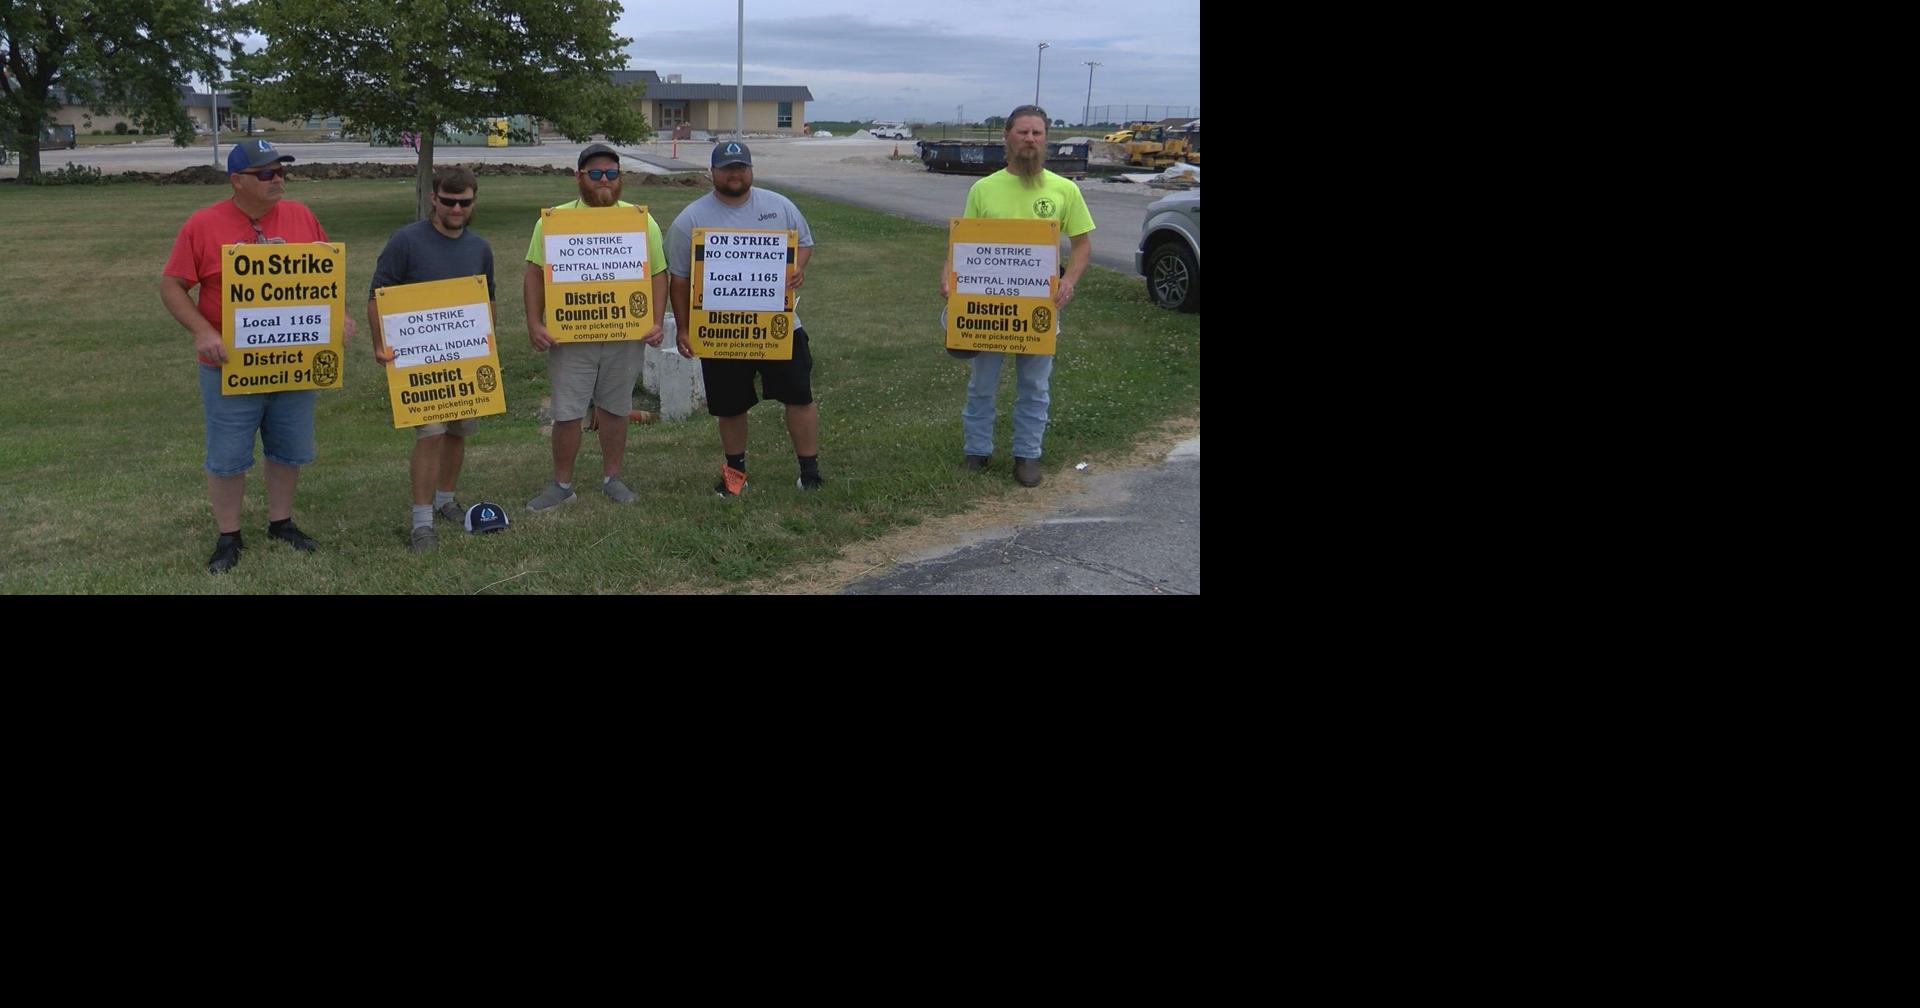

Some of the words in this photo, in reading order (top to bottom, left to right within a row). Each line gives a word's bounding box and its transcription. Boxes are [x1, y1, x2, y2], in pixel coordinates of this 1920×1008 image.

[758, 212, 777, 222] Jeep
[569, 237, 583, 246] ON
[586, 236, 623, 245] STRIKE
[710, 236, 728, 245] ON
[733, 236, 780, 246] STRIKE
[560, 248, 574, 257] NO
[577, 246, 633, 256] CONTRACT
[706, 250, 721, 258] NO
[725, 251, 785, 260] CONTRACT
[976, 247, 991, 255] ON
[994, 247, 1032, 256] STRIKE
[234, 255, 264, 276] On
[268, 254, 333, 274] Strike
[552, 263, 598, 272] CENTRAL
[602, 260, 643, 270] INDIANA
[966, 257, 981, 265] NO
[984, 258, 1041, 267] CONTRACT
[581, 272, 615, 281] GLASS
[710, 272, 742, 282] Local
[750, 273, 778, 282] 1165
[957, 275, 1004, 285] CENTRAL
[1007, 277, 1050, 286] INDIANA
[231, 284, 254, 302] No
[261, 281, 337, 301] Contract
[713, 287, 775, 297] GLAZIERS
[985, 287, 1020, 296] GLASS
[565, 291, 616, 305] District
[556, 306, 608, 322] Council
[611, 306, 626, 319] 91
[967, 301, 1018, 316] District
[243, 316, 280, 328] Local
[290, 315, 322, 325] 1165
[408, 314, 423, 324] ON
[426, 309, 464, 322] STRIKE
[709, 312, 758, 325] District
[400, 326, 415, 337] NO
[418, 319, 476, 334] CONTRACT
[561, 323, 574, 331] We
[589, 322, 624, 331] picketing
[957, 316, 1008, 331] Council
[1012, 319, 1028, 332] 91
[247, 331, 319, 345] GLAZIERS
[573, 332, 608, 340] company
[698, 326, 749, 339] Council
[752, 327, 767, 339] 91
[988, 333, 1024, 342] picketing
[393, 343, 443, 357] CENTRAL
[445, 337, 488, 350] INDIANA
[729, 341, 763, 349] picketing
[972, 342, 1007, 351] company
[243, 350, 303, 366] District
[425, 352, 460, 364] GLASS
[228, 371, 288, 387] Council
[294, 369, 311, 382] 91
[409, 367, 462, 387] District
[401, 385, 456, 405] Council
[459, 381, 475, 396] 91
[408, 405, 421, 414] We
[423, 404, 436, 412] are
[437, 398, 474, 410] picketing
[422, 410, 458, 422] company
